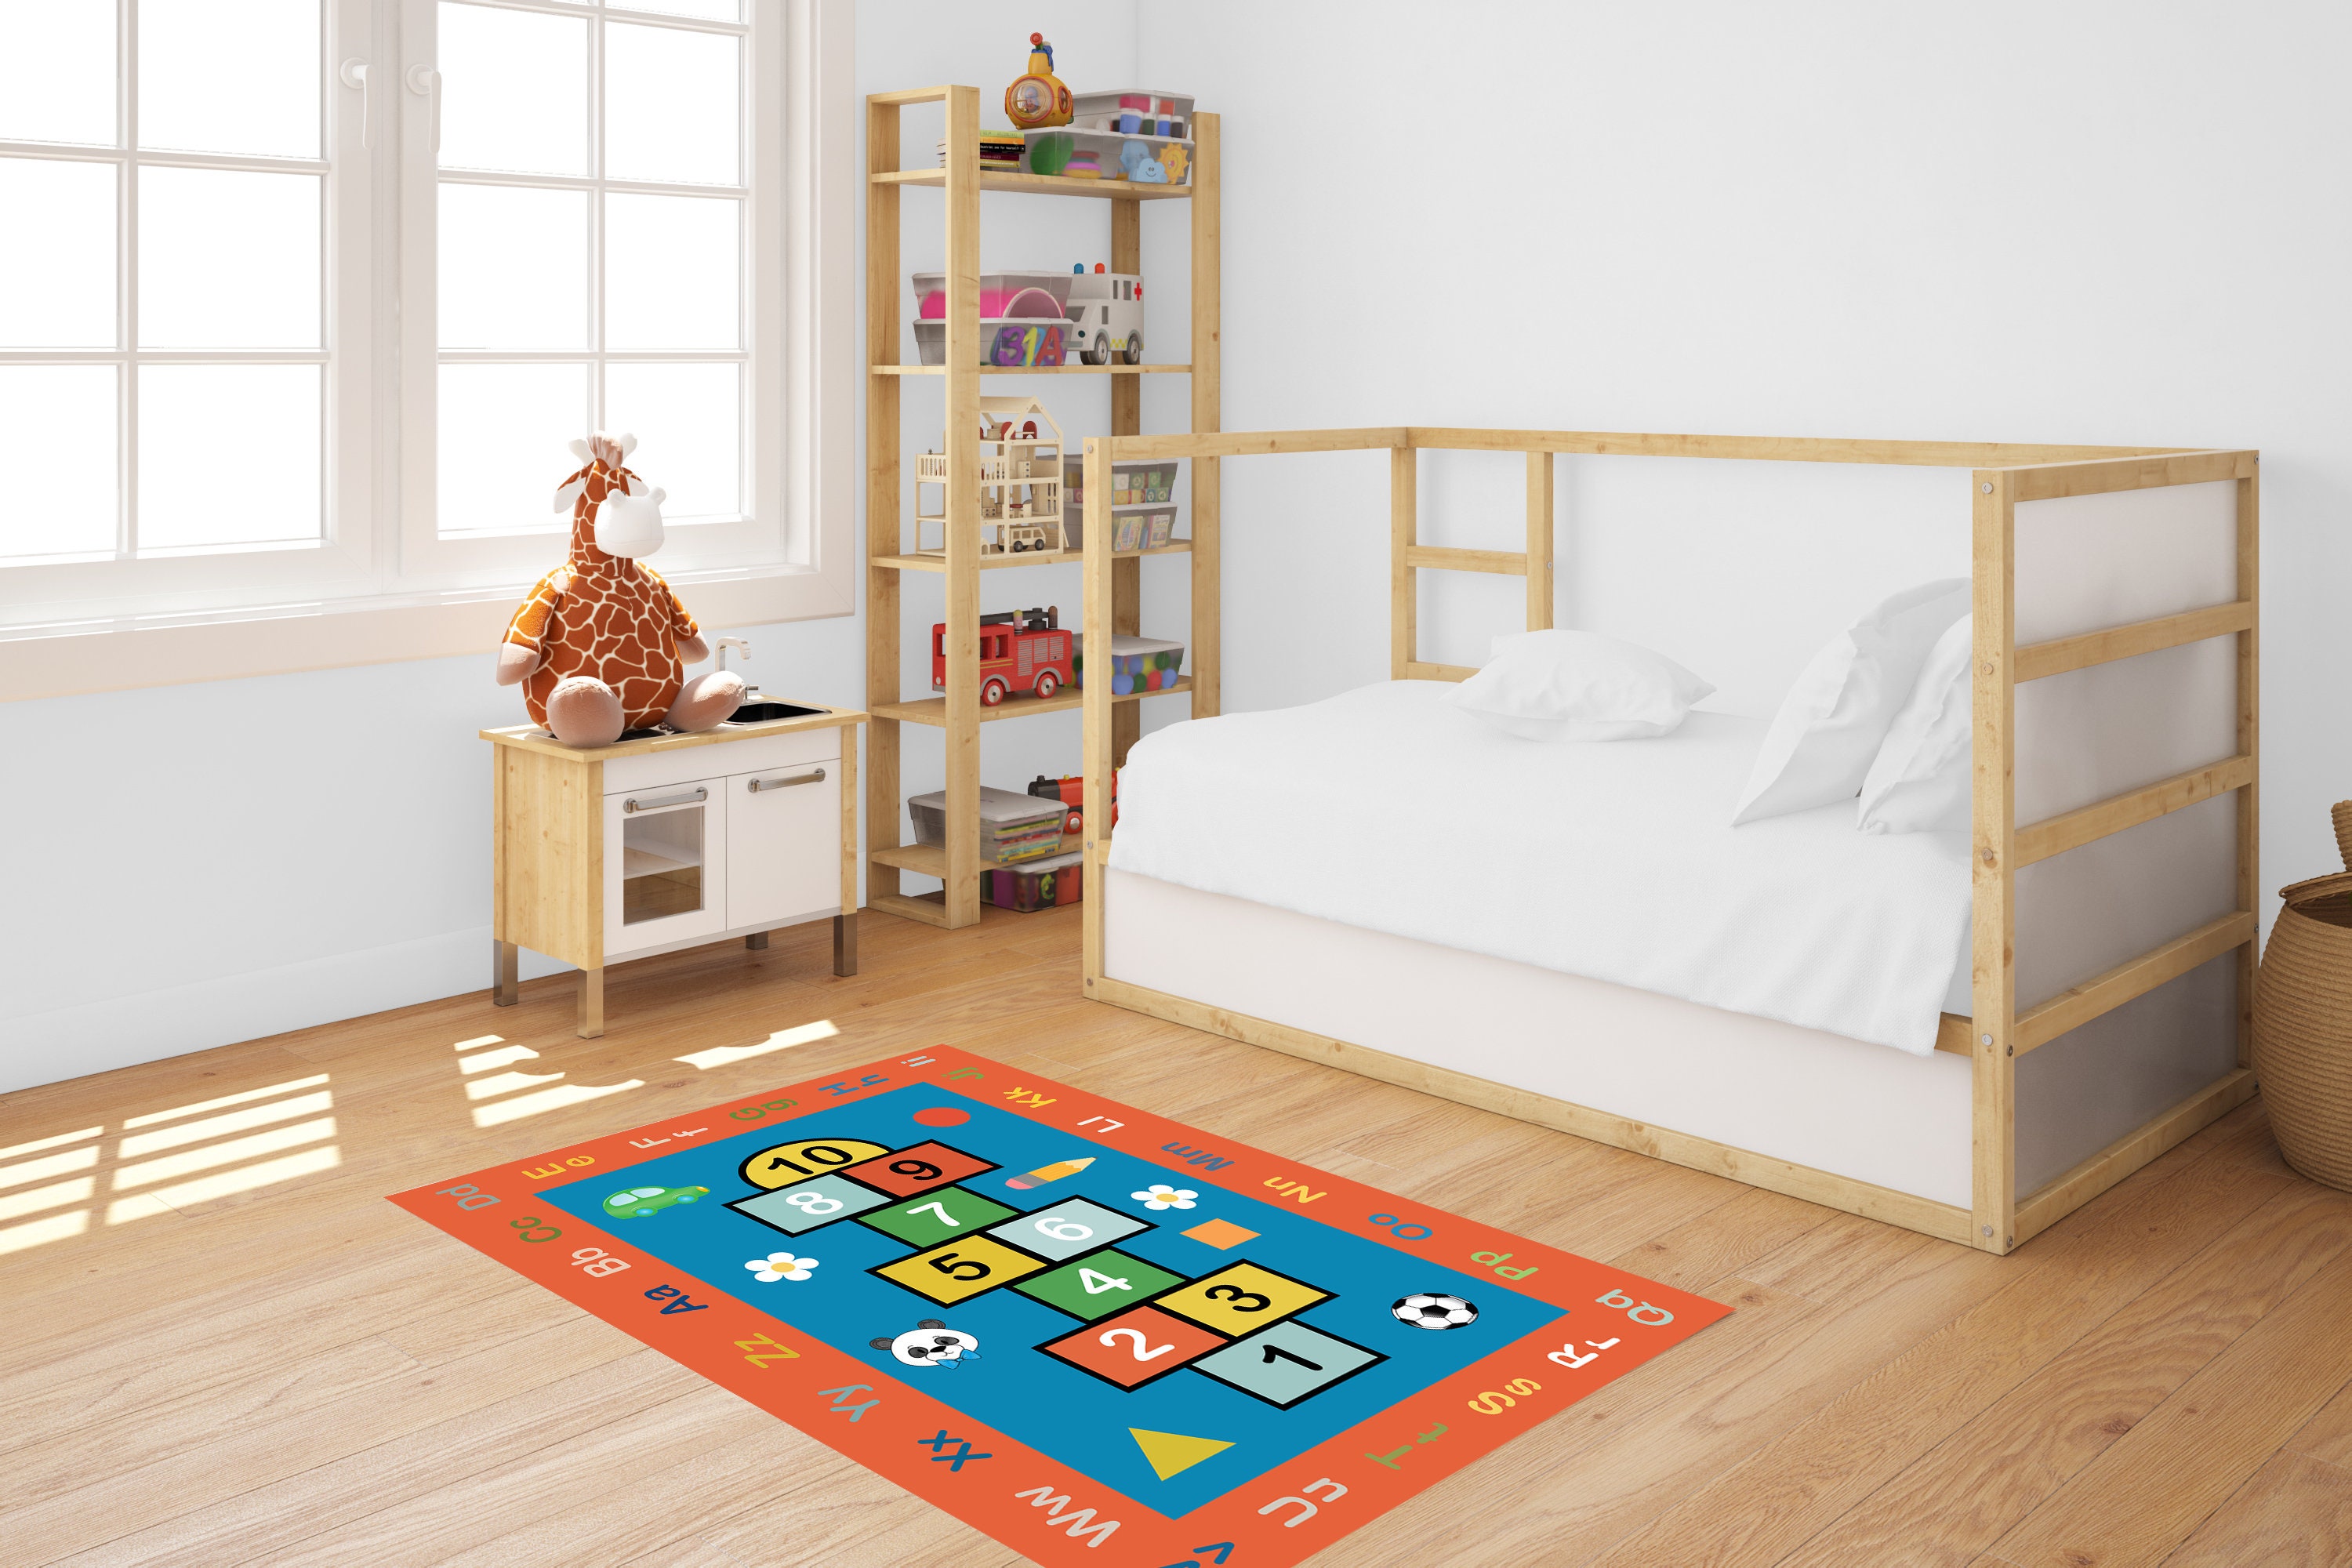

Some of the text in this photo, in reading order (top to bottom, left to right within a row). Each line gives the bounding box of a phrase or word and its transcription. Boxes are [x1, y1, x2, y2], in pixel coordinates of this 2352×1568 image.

[818, 1074, 890, 1096] Hh
[941, 1067, 984, 1080] Jj
[729, 1099, 798, 1120] Gg
[1004, 1087, 1057, 1108] Kk
[629, 1128, 708, 1149] Ff
[521, 1156, 595, 1179] Ee
[768, 1146, 853, 1175] 10
[889, 1160, 943, 1180] 9
[1160, 1142, 1235, 1171] Mm
[436, 1184, 501, 1210] Dd
[786, 1192, 843, 1214] 8
[1264, 1177, 1327, 1203] Nn
[907, 1202, 960, 1226] 7
[1368, 1213, 1433, 1240] Oo
[510, 1217, 562, 1243] Cc
[1034, 1218, 1090, 1240] 6
[572, 1248, 631, 1277] Bb
[928, 1253, 991, 1281] 5
[1471, 1251, 1538, 1280] Pp
[1078, 1268, 1132, 1294] 4
[644, 1284, 709, 1315] Aa
[1205, 1285, 1270, 1312] 3
[1595, 1289, 1674, 1327] Qq
[734, 1333, 800, 1368] Zz
[1099, 1328, 1175, 1361] 2
[1263, 1345, 1323, 1371] 1
[1548, 1338, 1621, 1369] Rr
[818, 1385, 880, 1422] Yy
[1468, 1378, 1541, 1414] Ss
[917, 1429, 993, 1472] Xx
[1365, 1422, 1448, 1470] Tt
[1258, 1478, 1348, 1527] Uu
[1015, 1486, 1120, 1548] Ww
[1159, 1541, 1235, 1568] v
